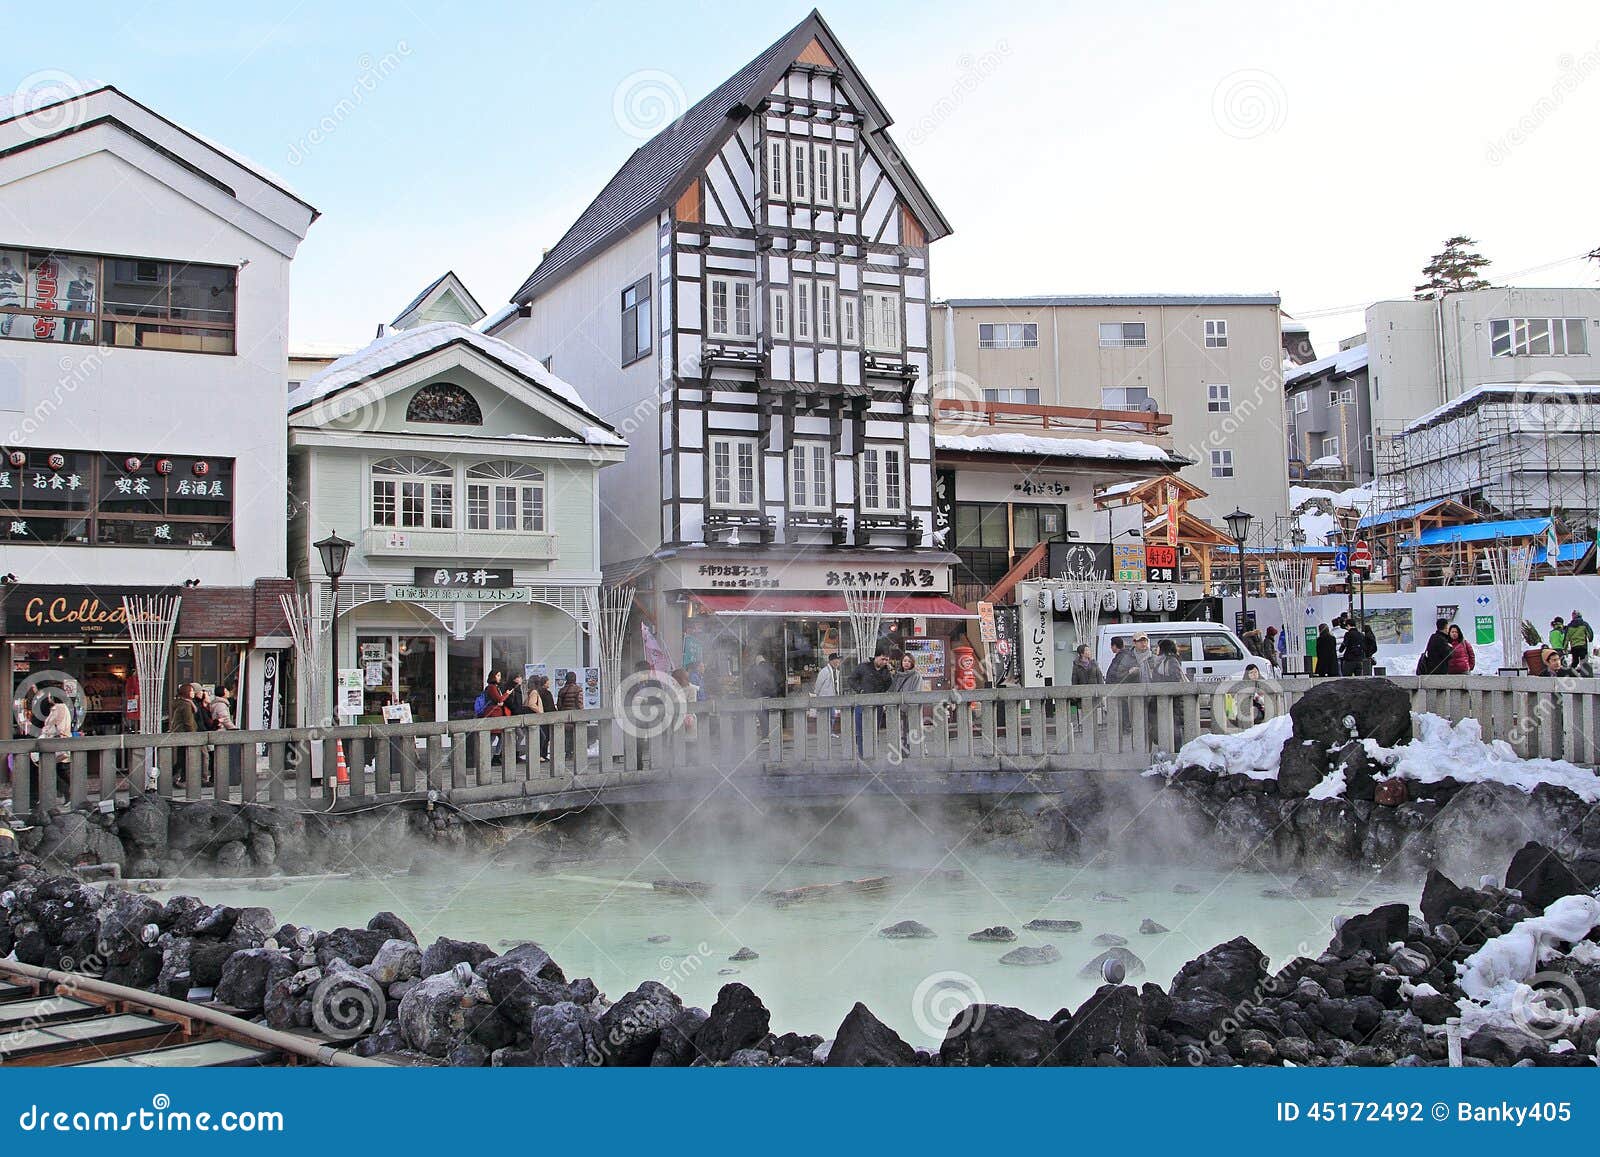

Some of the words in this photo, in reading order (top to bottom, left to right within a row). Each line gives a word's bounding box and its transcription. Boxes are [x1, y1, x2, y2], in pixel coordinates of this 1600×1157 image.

[33, 472, 82, 490] お食事
[114, 477, 151, 494] 喫茶
[175, 479, 225, 497] 居酒屋
[1149, 549, 1174, 565] 射的
[1151, 568, 1172, 581] 2階
